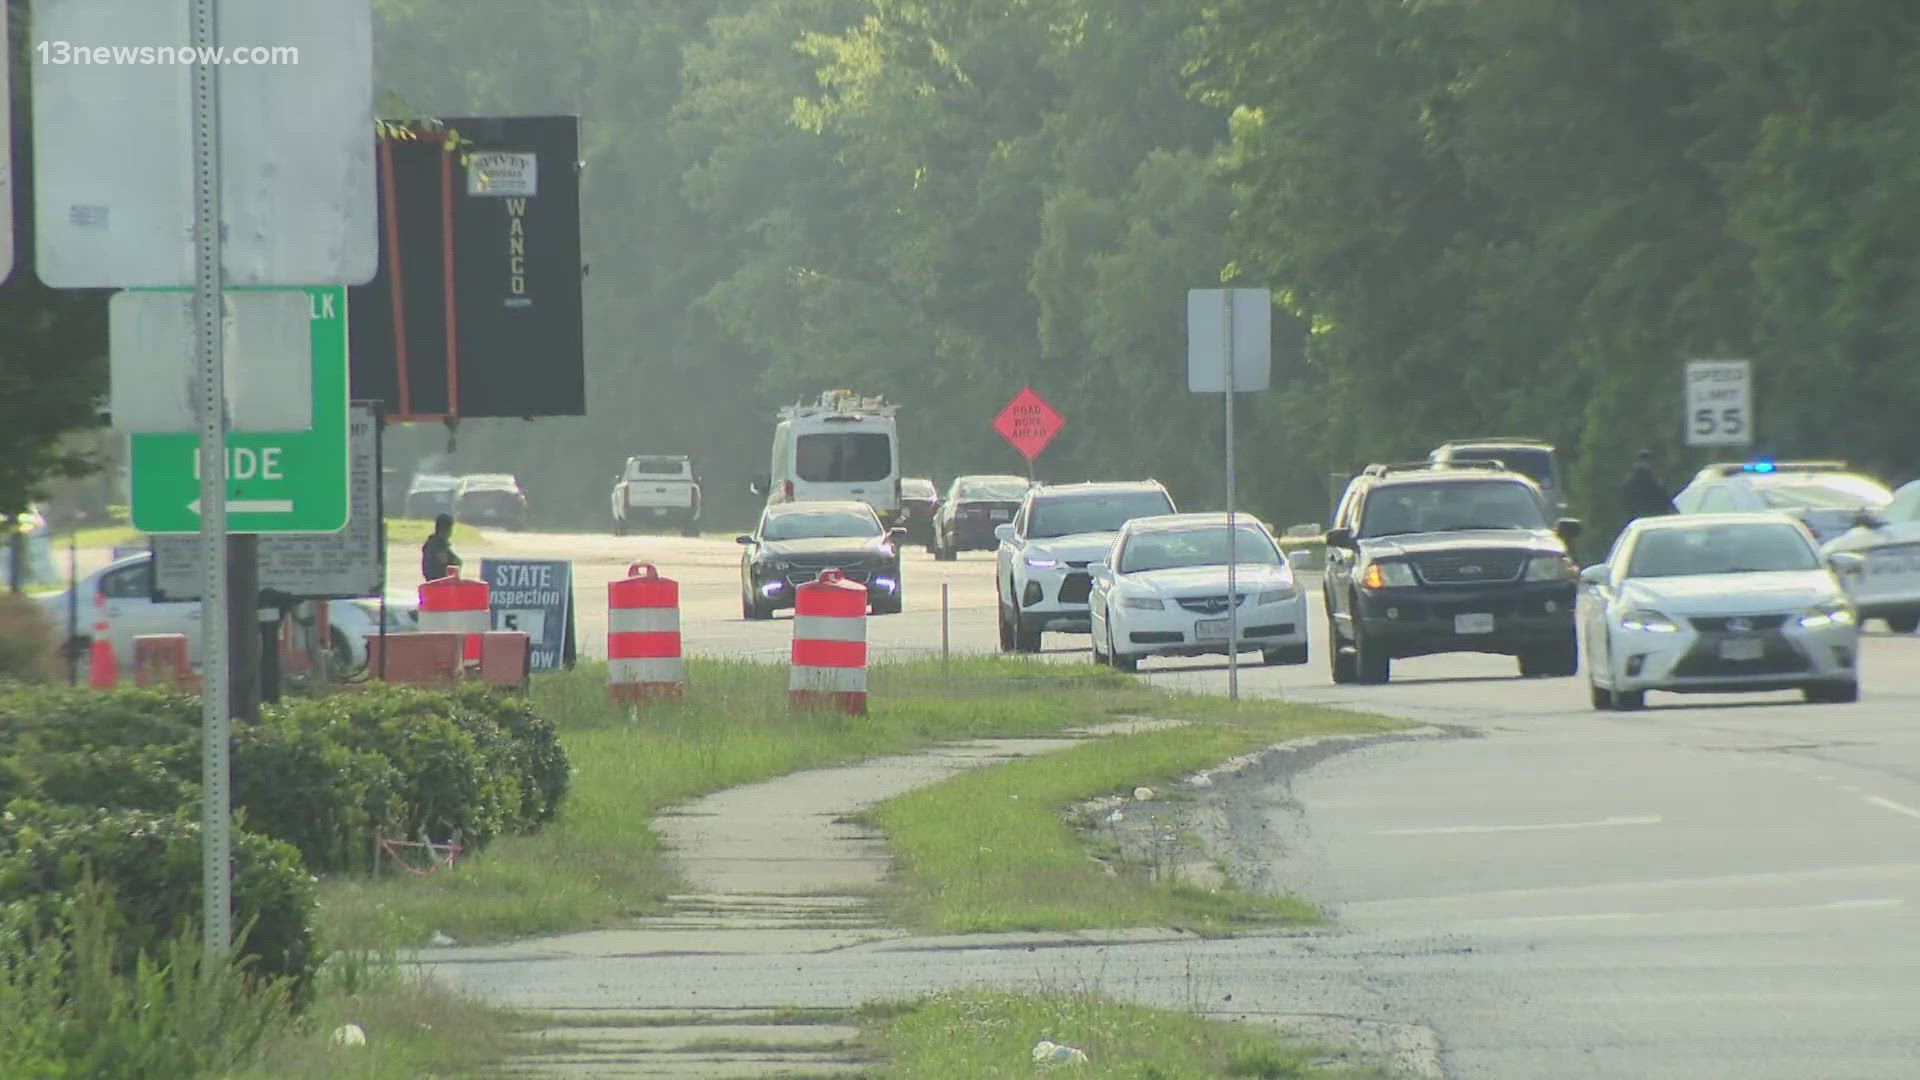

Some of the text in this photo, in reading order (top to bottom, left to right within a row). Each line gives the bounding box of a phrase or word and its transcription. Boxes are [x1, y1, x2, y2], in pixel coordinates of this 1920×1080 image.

[505, 198, 526, 294] WANCO
[1692, 369, 1743, 383] SPEED
[1697, 390, 1739, 402] LIMIT
[1013, 405, 1041, 415] ROAD
[1014, 418, 1042, 427] WORK
[1695, 409, 1743, 435] 55
[1012, 428, 1047, 439] AHEAD
[194, 447, 283, 480] IDE
[496, 564, 552, 588] STATE
[489, 588, 560, 608] nspection
[531, 650, 555, 668] OW
